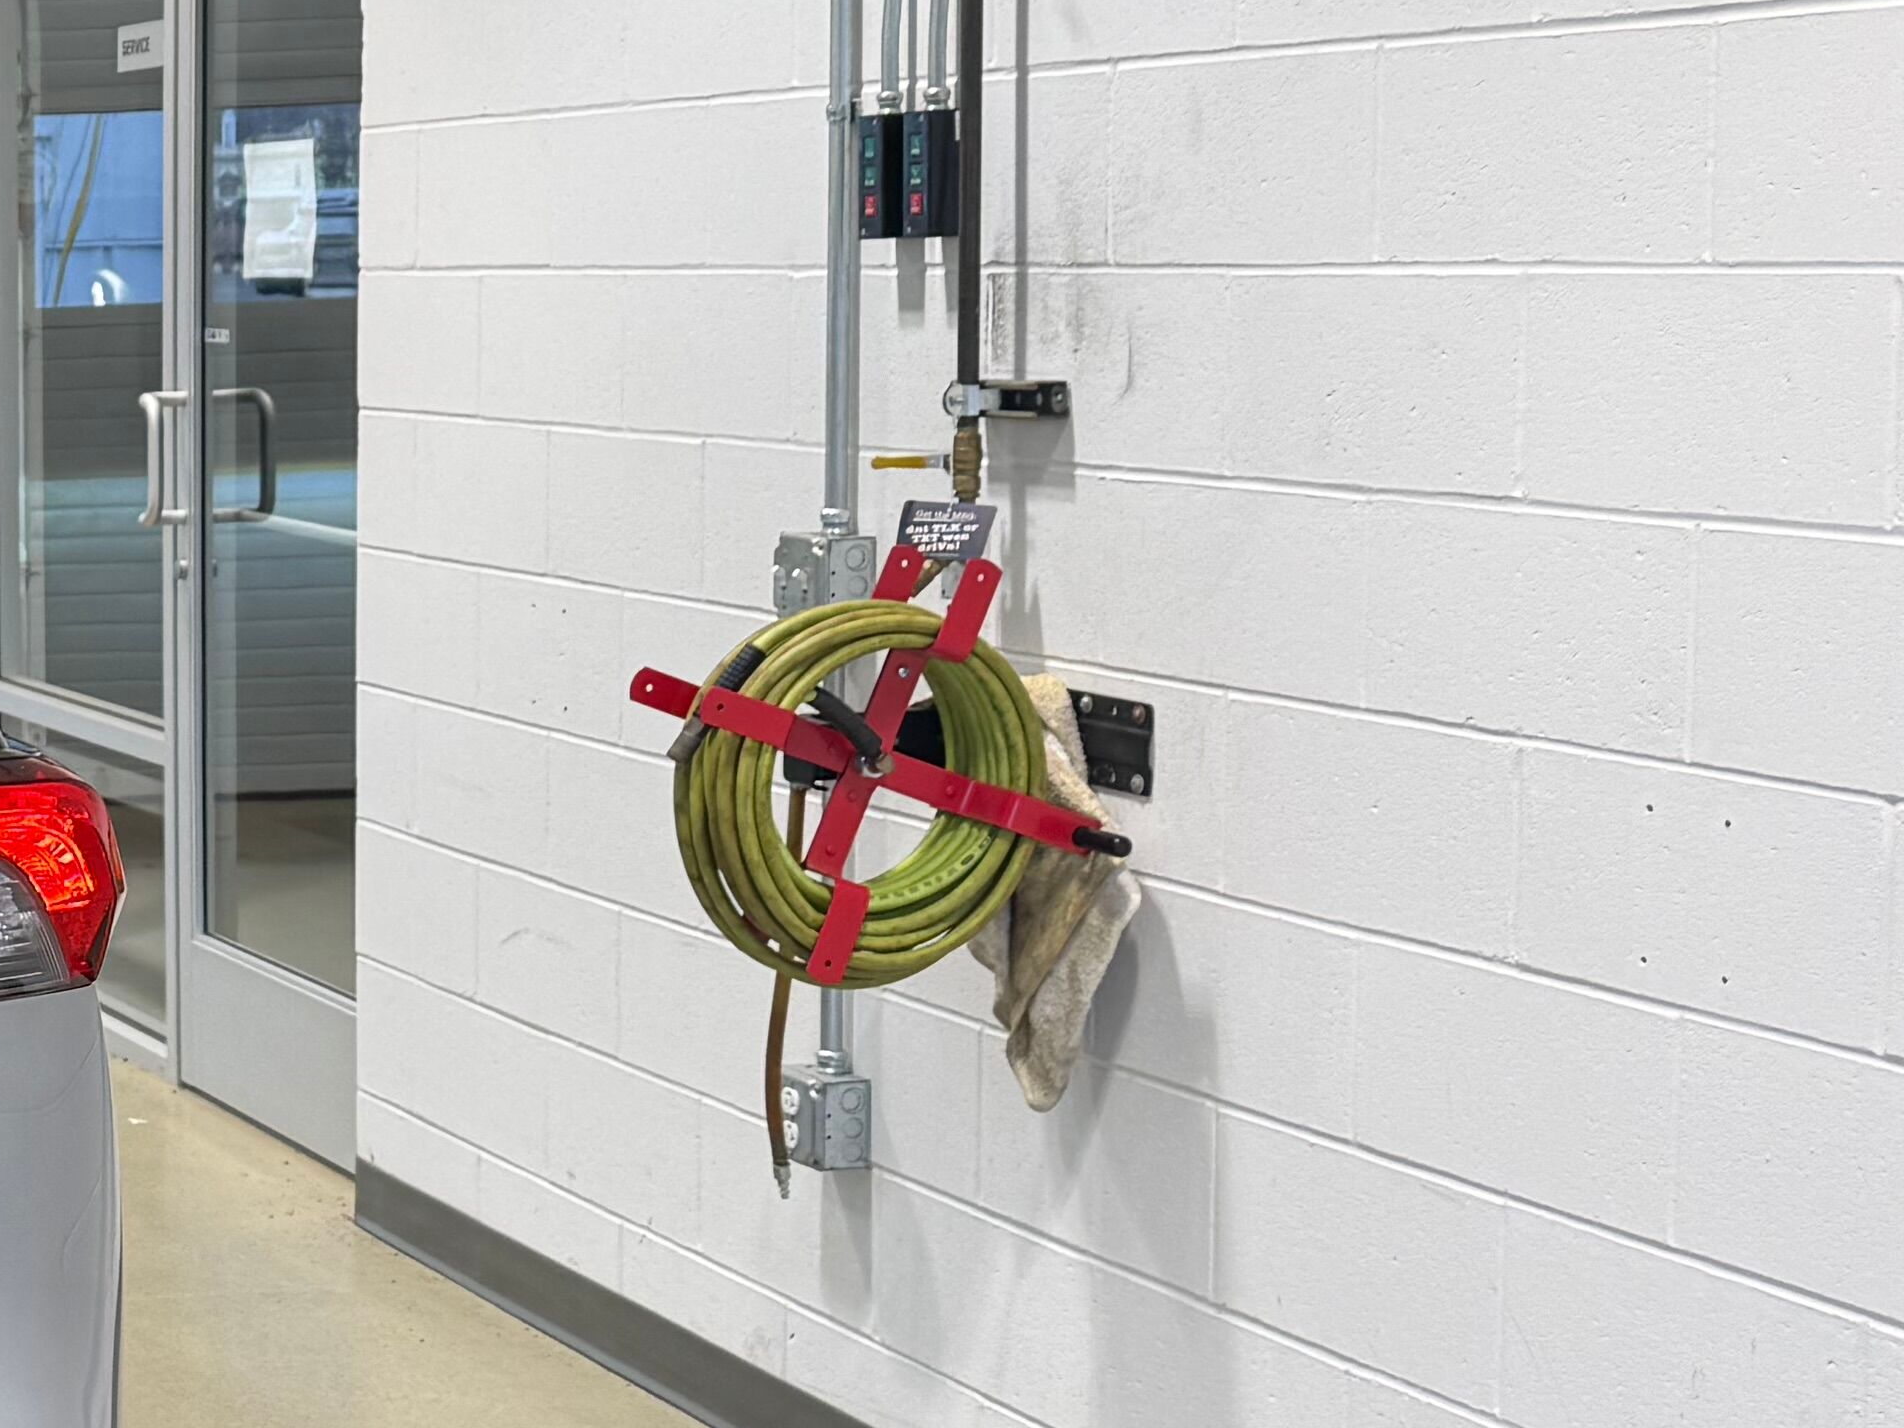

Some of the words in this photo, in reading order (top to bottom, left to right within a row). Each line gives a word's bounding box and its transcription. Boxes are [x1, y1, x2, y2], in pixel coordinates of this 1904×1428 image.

[931, 523, 961, 533] TLK
[963, 524, 980, 532] or
[911, 533, 940, 543] TXT
